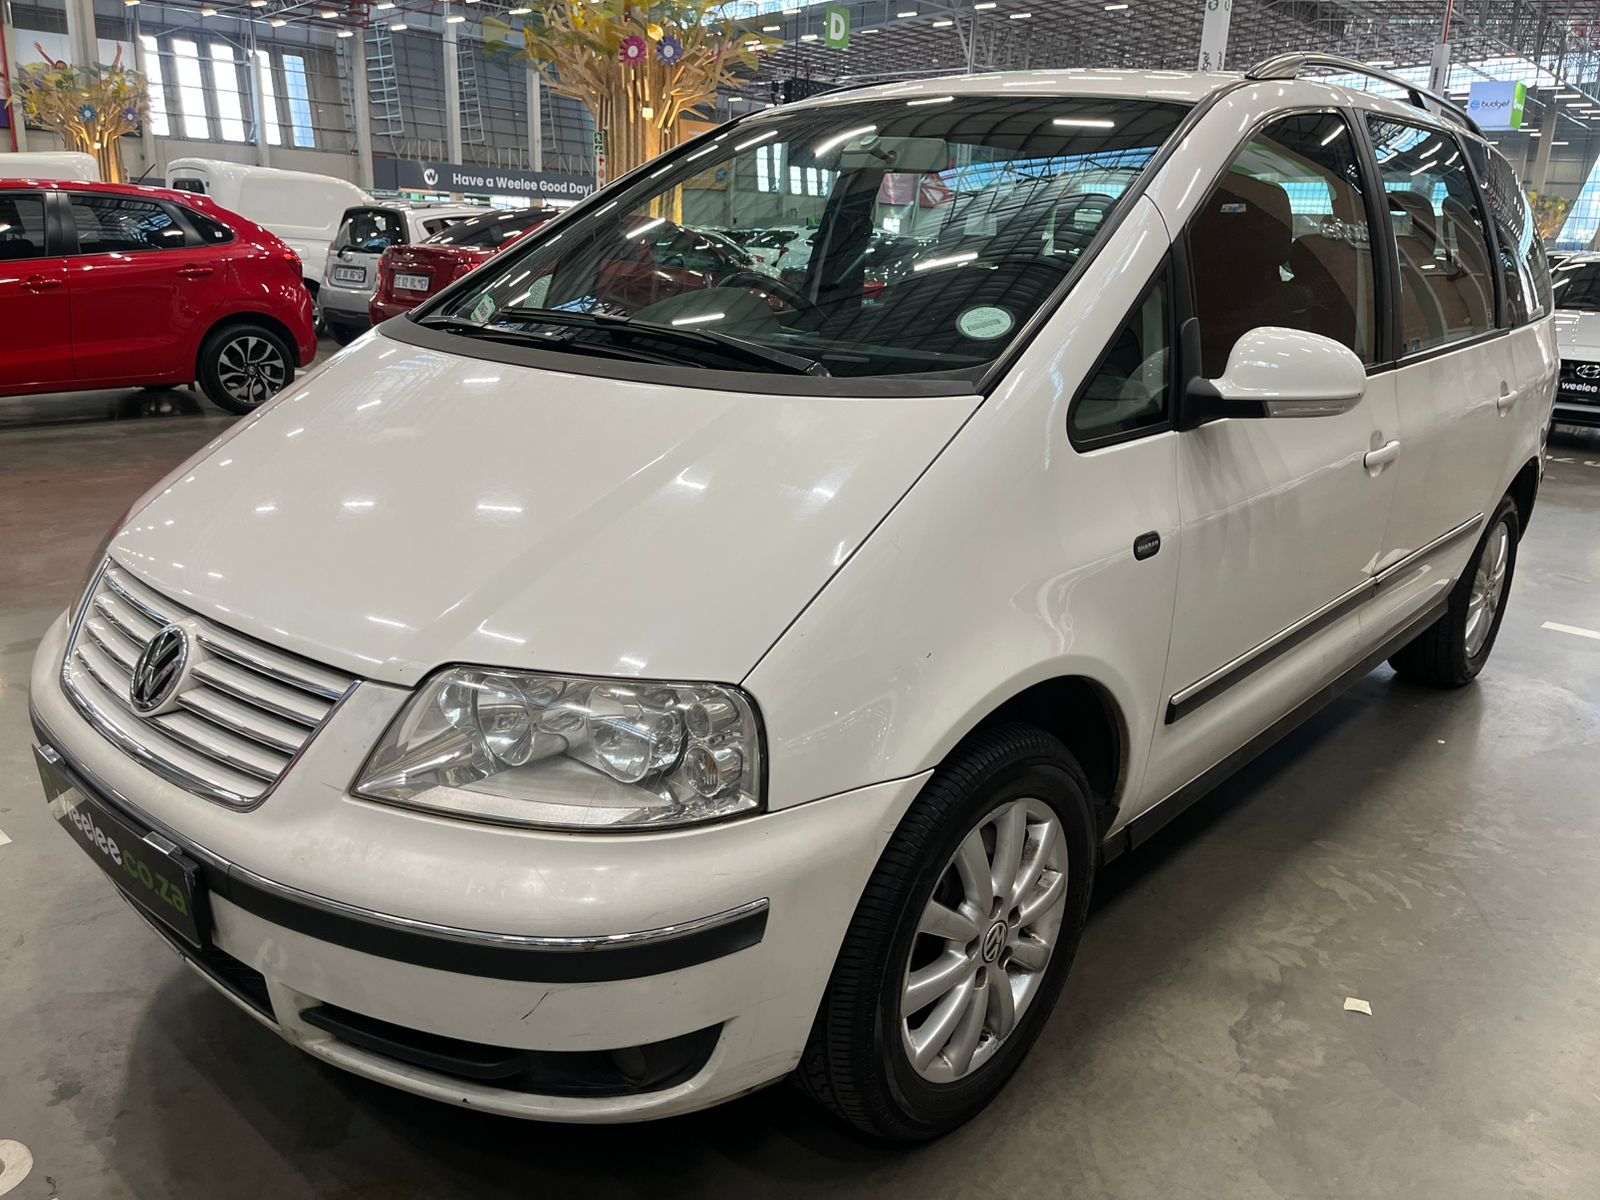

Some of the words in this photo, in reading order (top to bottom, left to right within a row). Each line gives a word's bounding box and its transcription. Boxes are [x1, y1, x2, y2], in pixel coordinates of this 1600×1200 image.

[830, 12, 845, 40] D
[453, 173, 483, 187] Have
[486, 178, 494, 187] a
[496, 177, 537, 190] Weelee
[540, 180, 567, 192] Good
[569, 182, 593, 197] Day!
[1561, 382, 1598, 393] weelee
[56, 787, 188, 917] weelee.co.za
